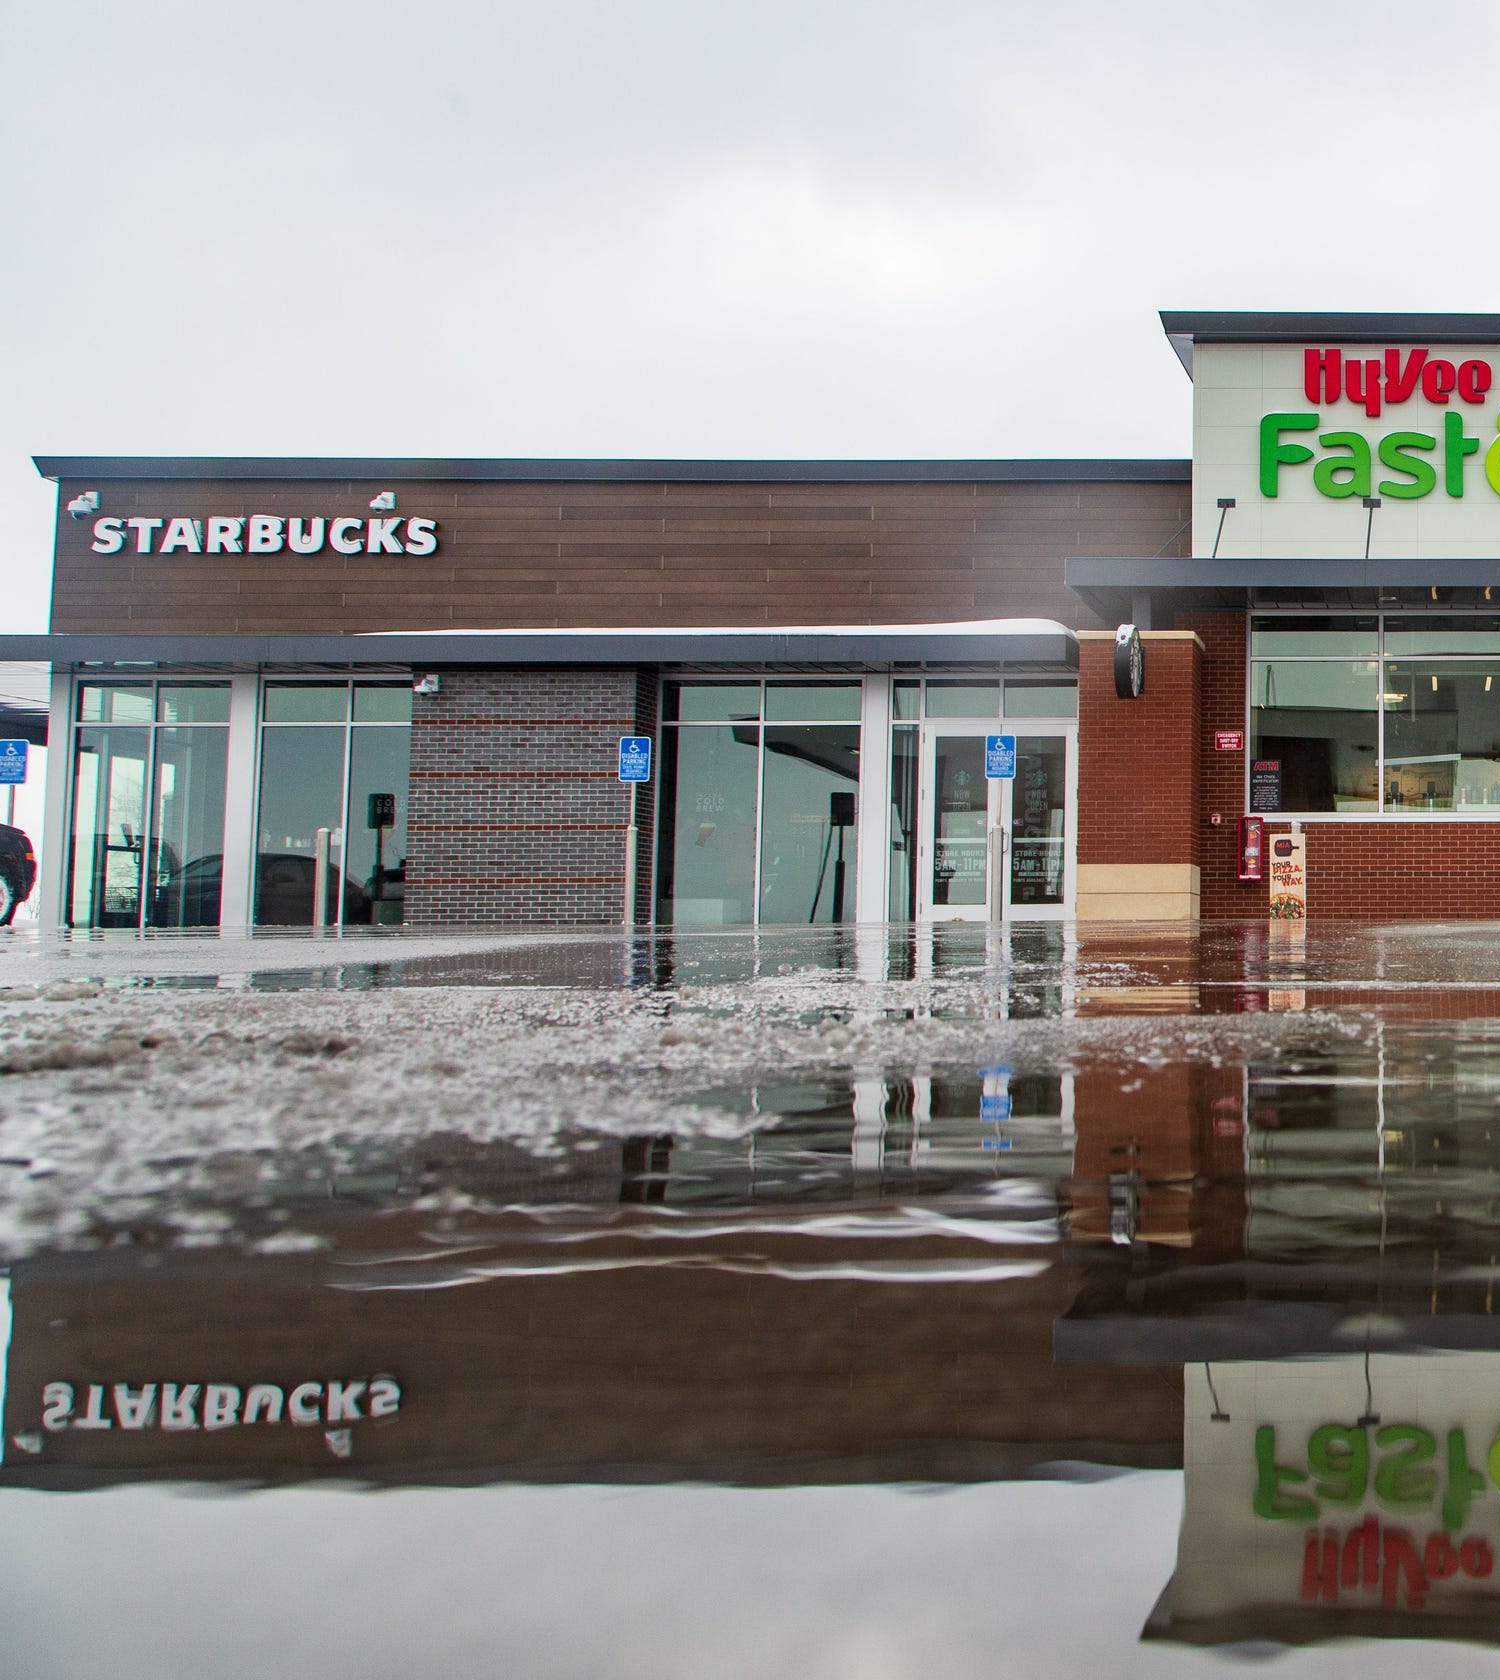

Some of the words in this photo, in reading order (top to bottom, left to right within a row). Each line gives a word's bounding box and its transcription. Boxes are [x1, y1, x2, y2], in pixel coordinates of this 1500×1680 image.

[91, 516, 439, 556] STARBUCKS
[1253, 761, 1279, 771] ATM
[1032, 788, 1048, 799] NOW
[1271, 861, 1291, 869] YOUR
[1273, 865, 1303, 875] PIZZA.
[1281, 877, 1303, 887] WAY.
